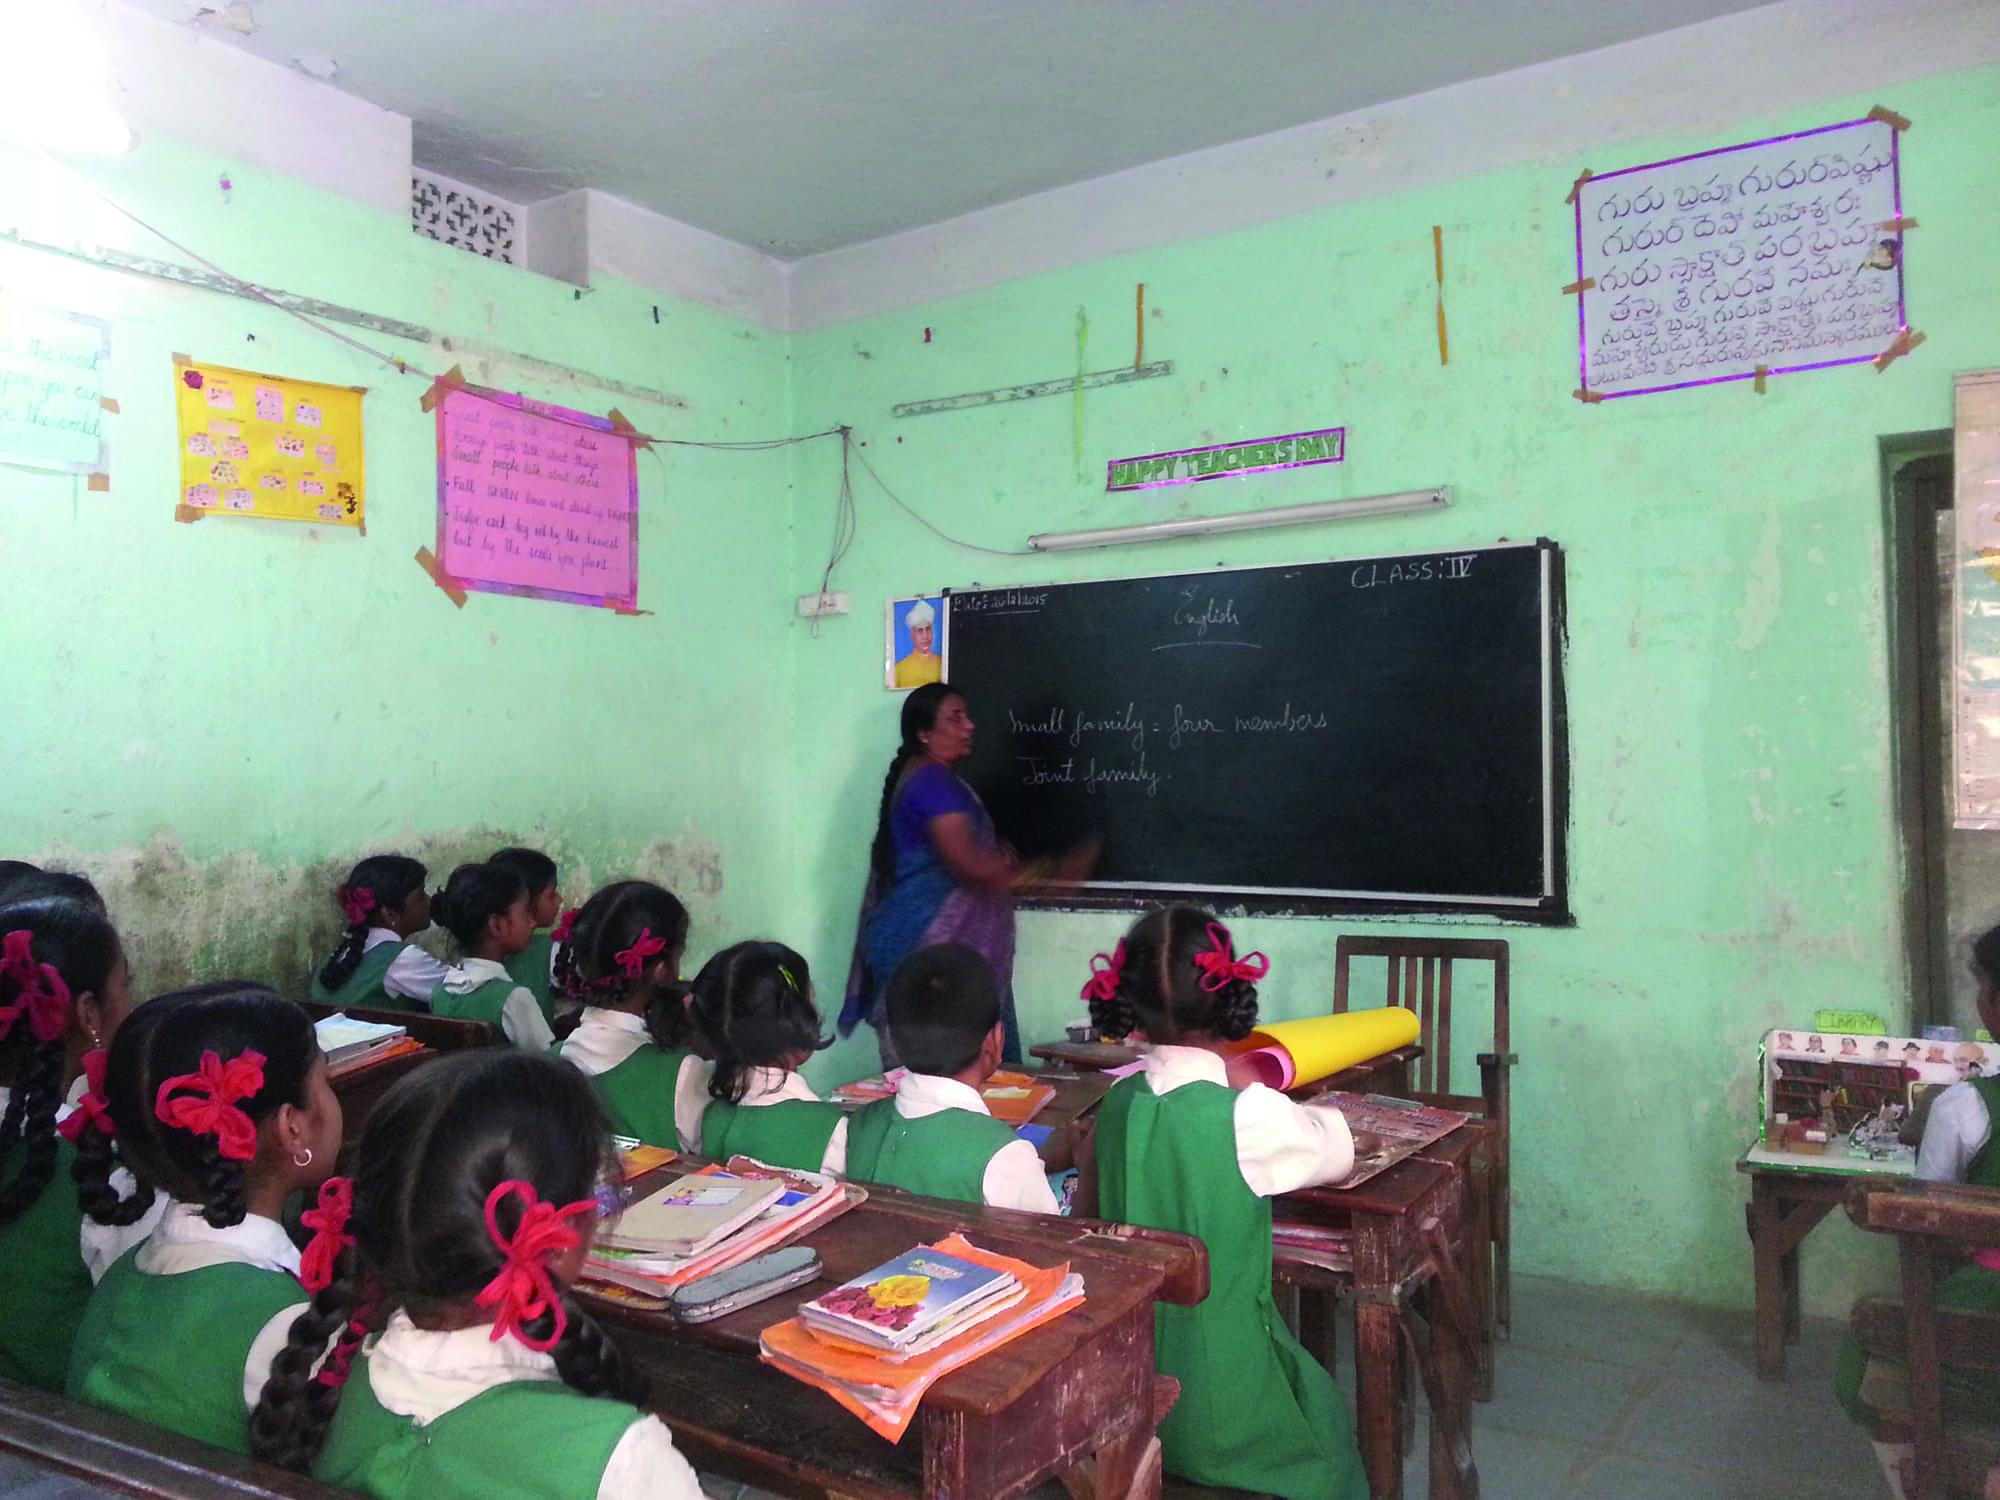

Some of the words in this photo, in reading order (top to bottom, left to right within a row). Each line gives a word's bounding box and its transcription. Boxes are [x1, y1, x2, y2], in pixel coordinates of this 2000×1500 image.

[1110, 457, 1177, 487] HAPPY
[1295, 432, 1341, 460] DAY
[1172, 584, 1240, 637] English
[1071, 702, 1145, 750] family
[1167, 703, 1224, 749] four
[1234, 702, 1328, 734] members
